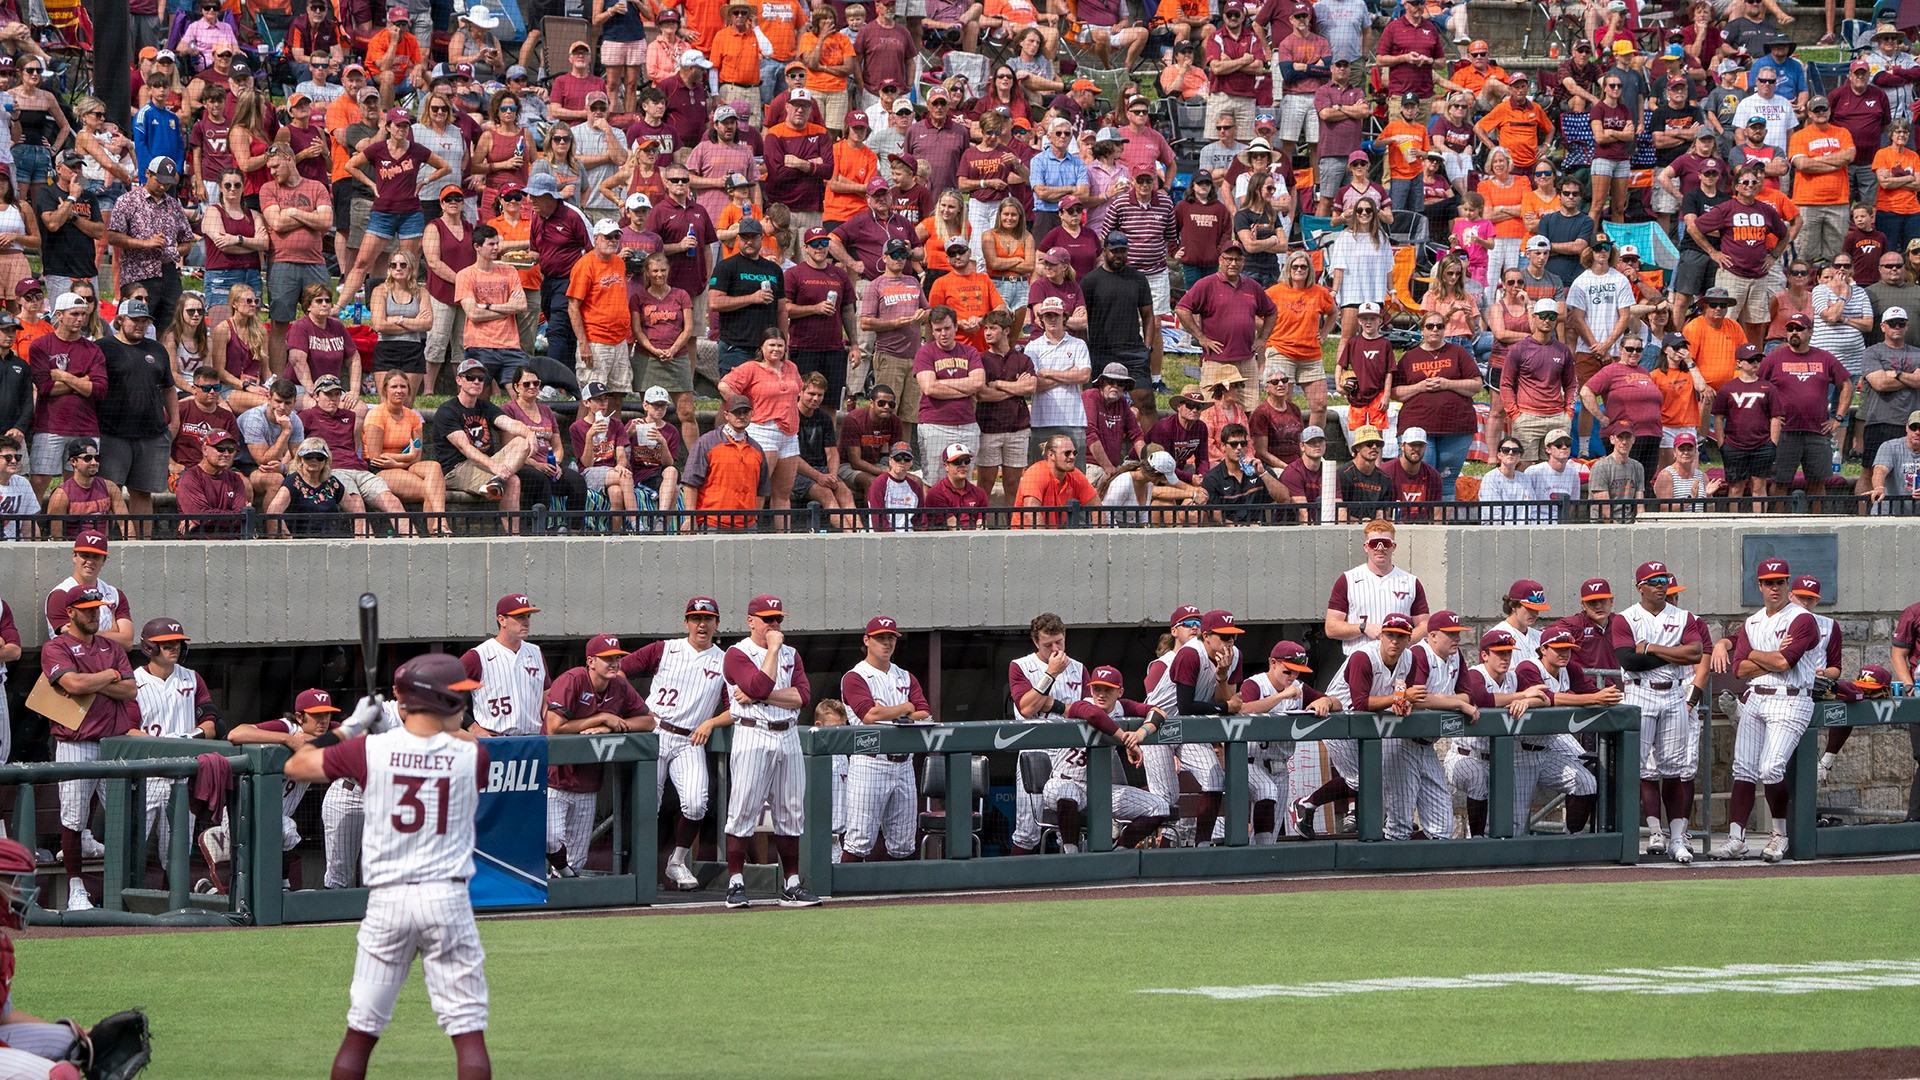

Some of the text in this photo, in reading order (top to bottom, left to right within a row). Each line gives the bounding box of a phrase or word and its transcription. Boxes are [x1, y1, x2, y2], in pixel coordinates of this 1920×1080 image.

[233, 63, 246, 71] VT
[1753, 106, 1787, 114] VIRGINIA
[977, 166, 999, 174] TECH
[898, 198, 910, 206] VT
[1190, 214, 1218, 222] VIRGINIA
[1732, 213, 1766, 227] GO
[1733, 227, 1767, 241] HOKIES
[1861, 245, 1878, 255] VT
[740, 273, 778, 284] ROGUE
[957, 286, 982, 294] VIRGINIA
[884, 294, 912, 305] HOKIES
[1363, 350, 1379, 359] VT
[1412, 359, 1452, 372] HOKIES
[1782, 363, 1808, 374] VIRGINIA
[1809, 362, 1824, 374] TECH
[1797, 375, 1810, 383] VT
[1731, 393, 1766, 409] VT
[469, 427, 483, 437] VT
[1403, 491, 1423, 502] VT
[86, 536, 101, 545] VT
[1648, 563, 1662, 571] VT
[1767, 563, 1782, 571] VT
[1589, 583, 1603, 591] VT
[1803, 580, 1817, 588] VT
[1393, 591, 1410, 600] VT
[878, 619, 893, 627] VT
[1222, 616, 1235, 624] VT
[1449, 615, 1460, 623] VT
[1584, 627, 1593, 635] VT
[1663, 624, 1680, 633] VT
[605, 638, 619, 646] VT
[70, 644, 83, 654] VT
[524, 667, 540, 677] VT
[704, 669, 721, 679] VT
[1097, 670, 1112, 678] VT
[177, 687, 194, 697] VT
[896, 687, 911, 695] VT
[1066, 682, 1082, 692] VT
[315, 694, 329, 702] VT
[581, 692, 594, 702] VT
[659, 688, 679, 708] 22
[488, 696, 513, 718] 35
[1372, 715, 1404, 738] VT
[1500, 712, 1533, 736] VT
[1220, 718, 1254, 742] VT
[920, 728, 955, 752] VT
[589, 736, 627, 762] VT
[389, 752, 456, 770] HURLEY
[391, 774, 451, 835] 31
